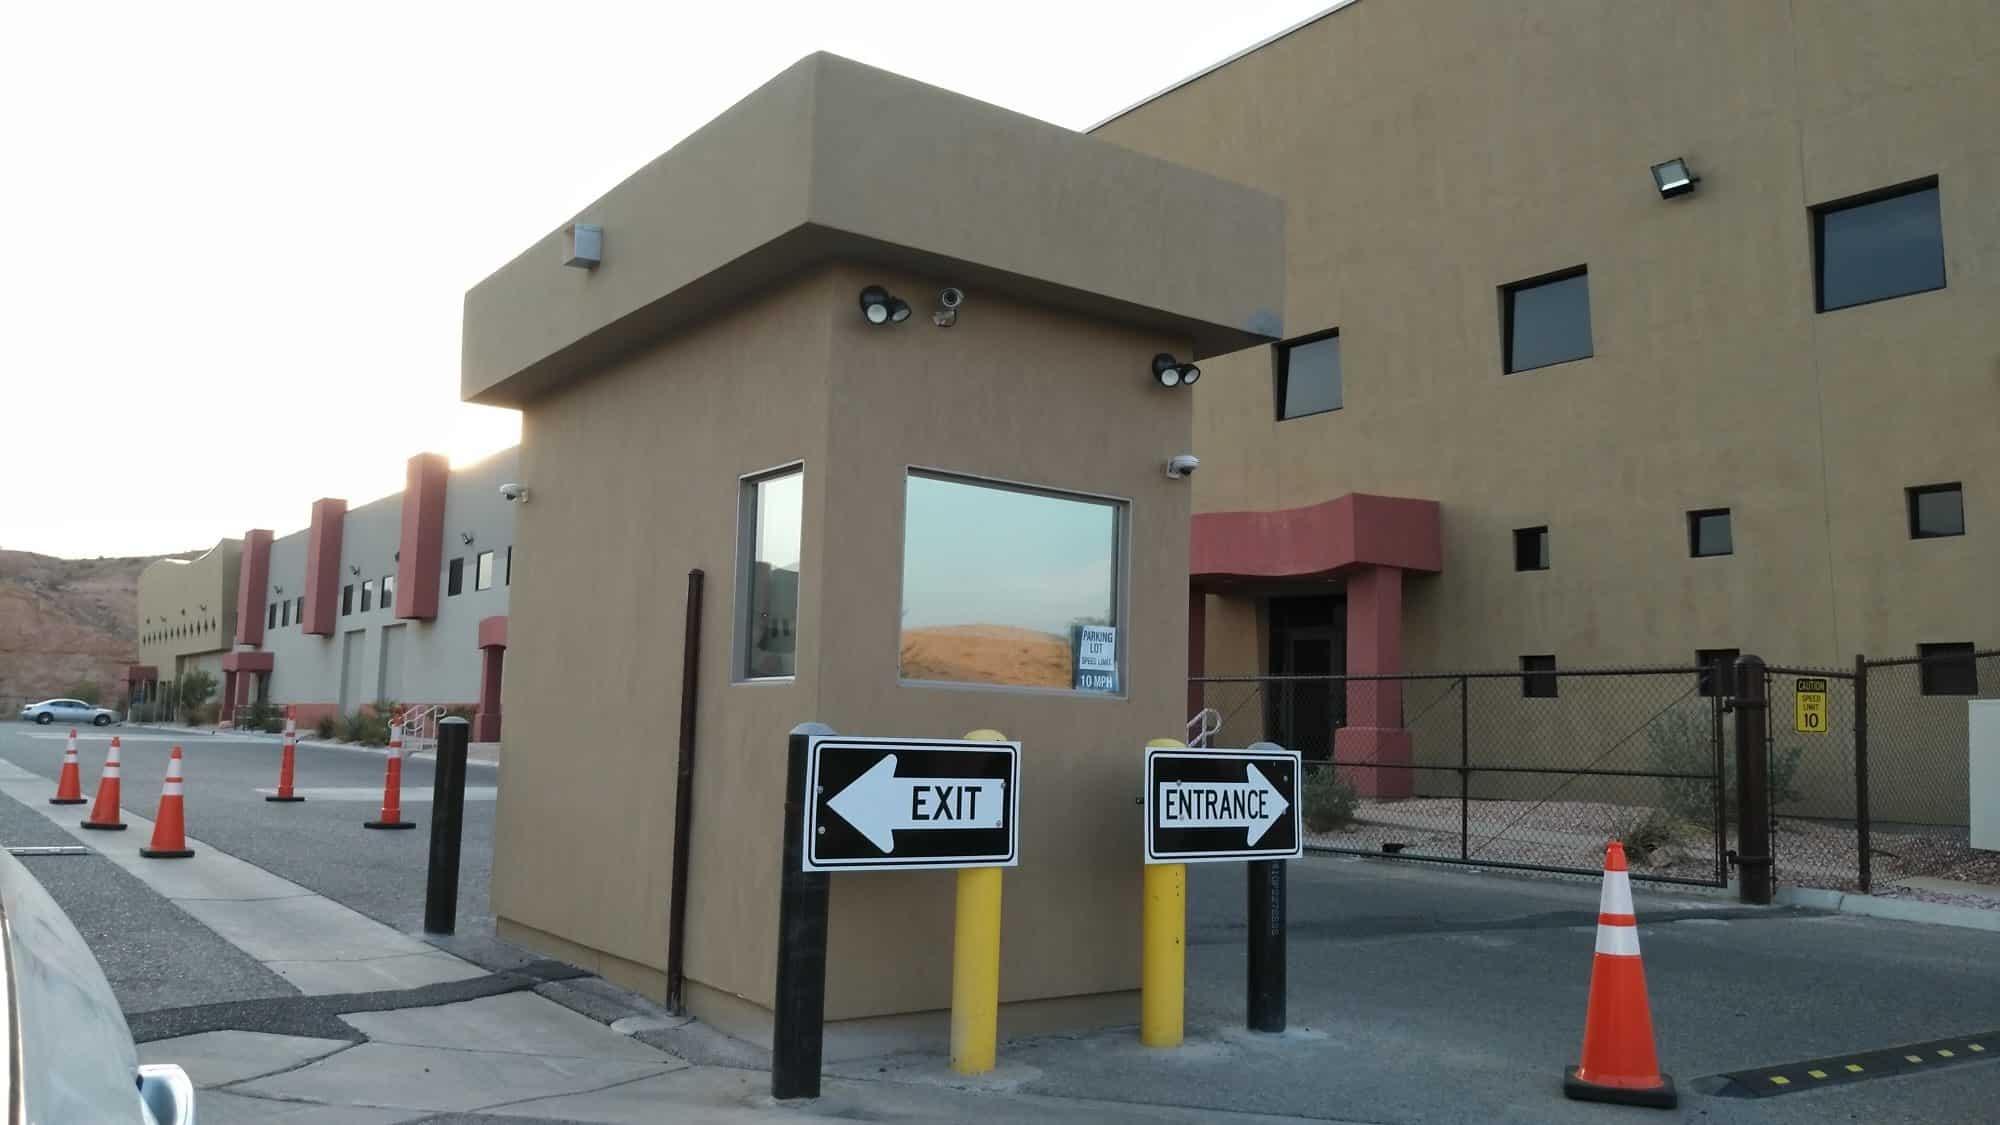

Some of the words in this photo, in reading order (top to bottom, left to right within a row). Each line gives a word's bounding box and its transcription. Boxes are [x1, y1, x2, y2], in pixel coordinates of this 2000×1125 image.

[1083, 630, 1113, 643] PARKING
[1090, 643, 1103, 653] LOT
[1081, 656, 1097, 665] SPEED
[1081, 675, 1092, 687] 10
[1094, 675, 1113, 688] MPH
[1799, 680, 1825, 690] CAUTION
[1802, 694, 1821, 702] SPEED
[1803, 703, 1819, 711] LIMIT
[1804, 712, 1819, 728] 10
[911, 786, 982, 821] EXIT
[1165, 789, 1269, 820] ENTRANCE
